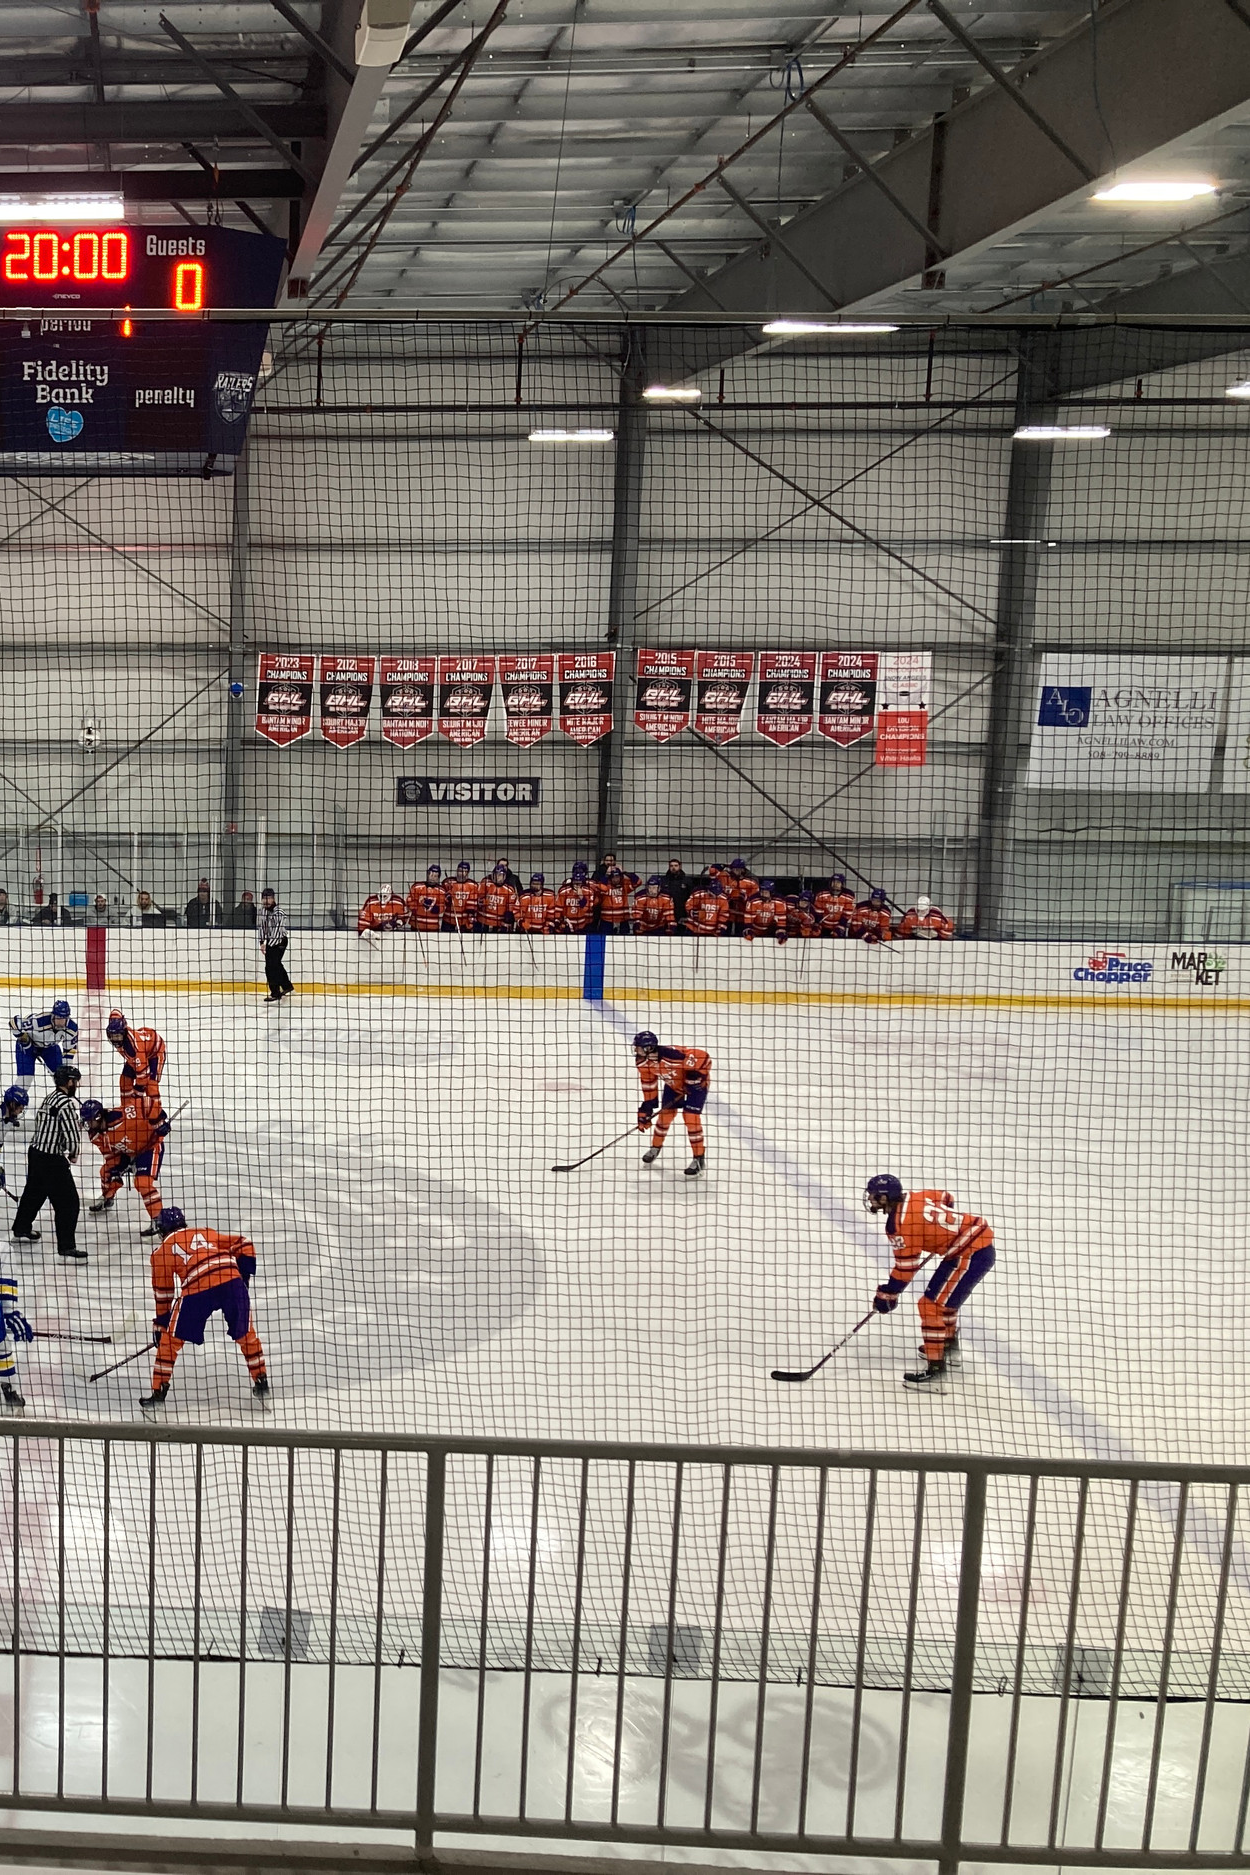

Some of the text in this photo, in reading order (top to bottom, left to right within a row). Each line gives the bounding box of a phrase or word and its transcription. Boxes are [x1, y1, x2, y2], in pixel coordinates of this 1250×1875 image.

[146, 234, 206, 256] Guests
[5, 231, 128, 280] 20:00
[174, 263, 203, 311] 0
[22, 360, 109, 386] Fidelity
[213, 373, 253, 392] RAILERS
[35, 382, 94, 404] Bank
[135, 386, 195, 408] penalty
[455, 658, 478, 671] 2017
[515, 657, 538, 670] 2017
[574, 655, 598, 668] 2016
[654, 652, 678, 665] 2015
[713, 655, 737, 667] 2015
[774, 655, 801, 668] 2024
[838, 655, 863, 667] 2024
[893, 655, 920, 666] 2024
[266, 669, 308, 680] CHAMPIONS
[326, 671, 368, 682] CHAMPIONS
[386, 672, 429, 682] CHAMPIONS
[445, 672, 488, 682] CHAMPIONS
[505, 670, 548, 681] CHAMPIONS
[564, 669, 607, 680] CHAMPIONS
[644, 665, 687, 676] CHAMPIONS
[702, 668, 746, 678] CHAMPIONS
[766, 668, 809, 679] CHAMPIONS
[827, 668, 871, 679] CHAMPIONS
[1094, 689, 1218, 710] AGNELLI
[701, 716, 716, 725] MITE
[1093, 714, 1215, 729] LAW OFFICES
[645, 723, 677, 732] AMERICAN
[1077, 736, 1176, 748] AGNELLILAW.COM
[428, 782, 533, 801] VISITOR
[705, 912, 714, 920] 17
[1108, 957, 1154, 972] Price
[1171, 952, 1208, 970] MAR
[1073, 967, 1152, 984] Chopper
[1195, 969, 1224, 986] KET
[171, 1232, 218, 1265] 14
